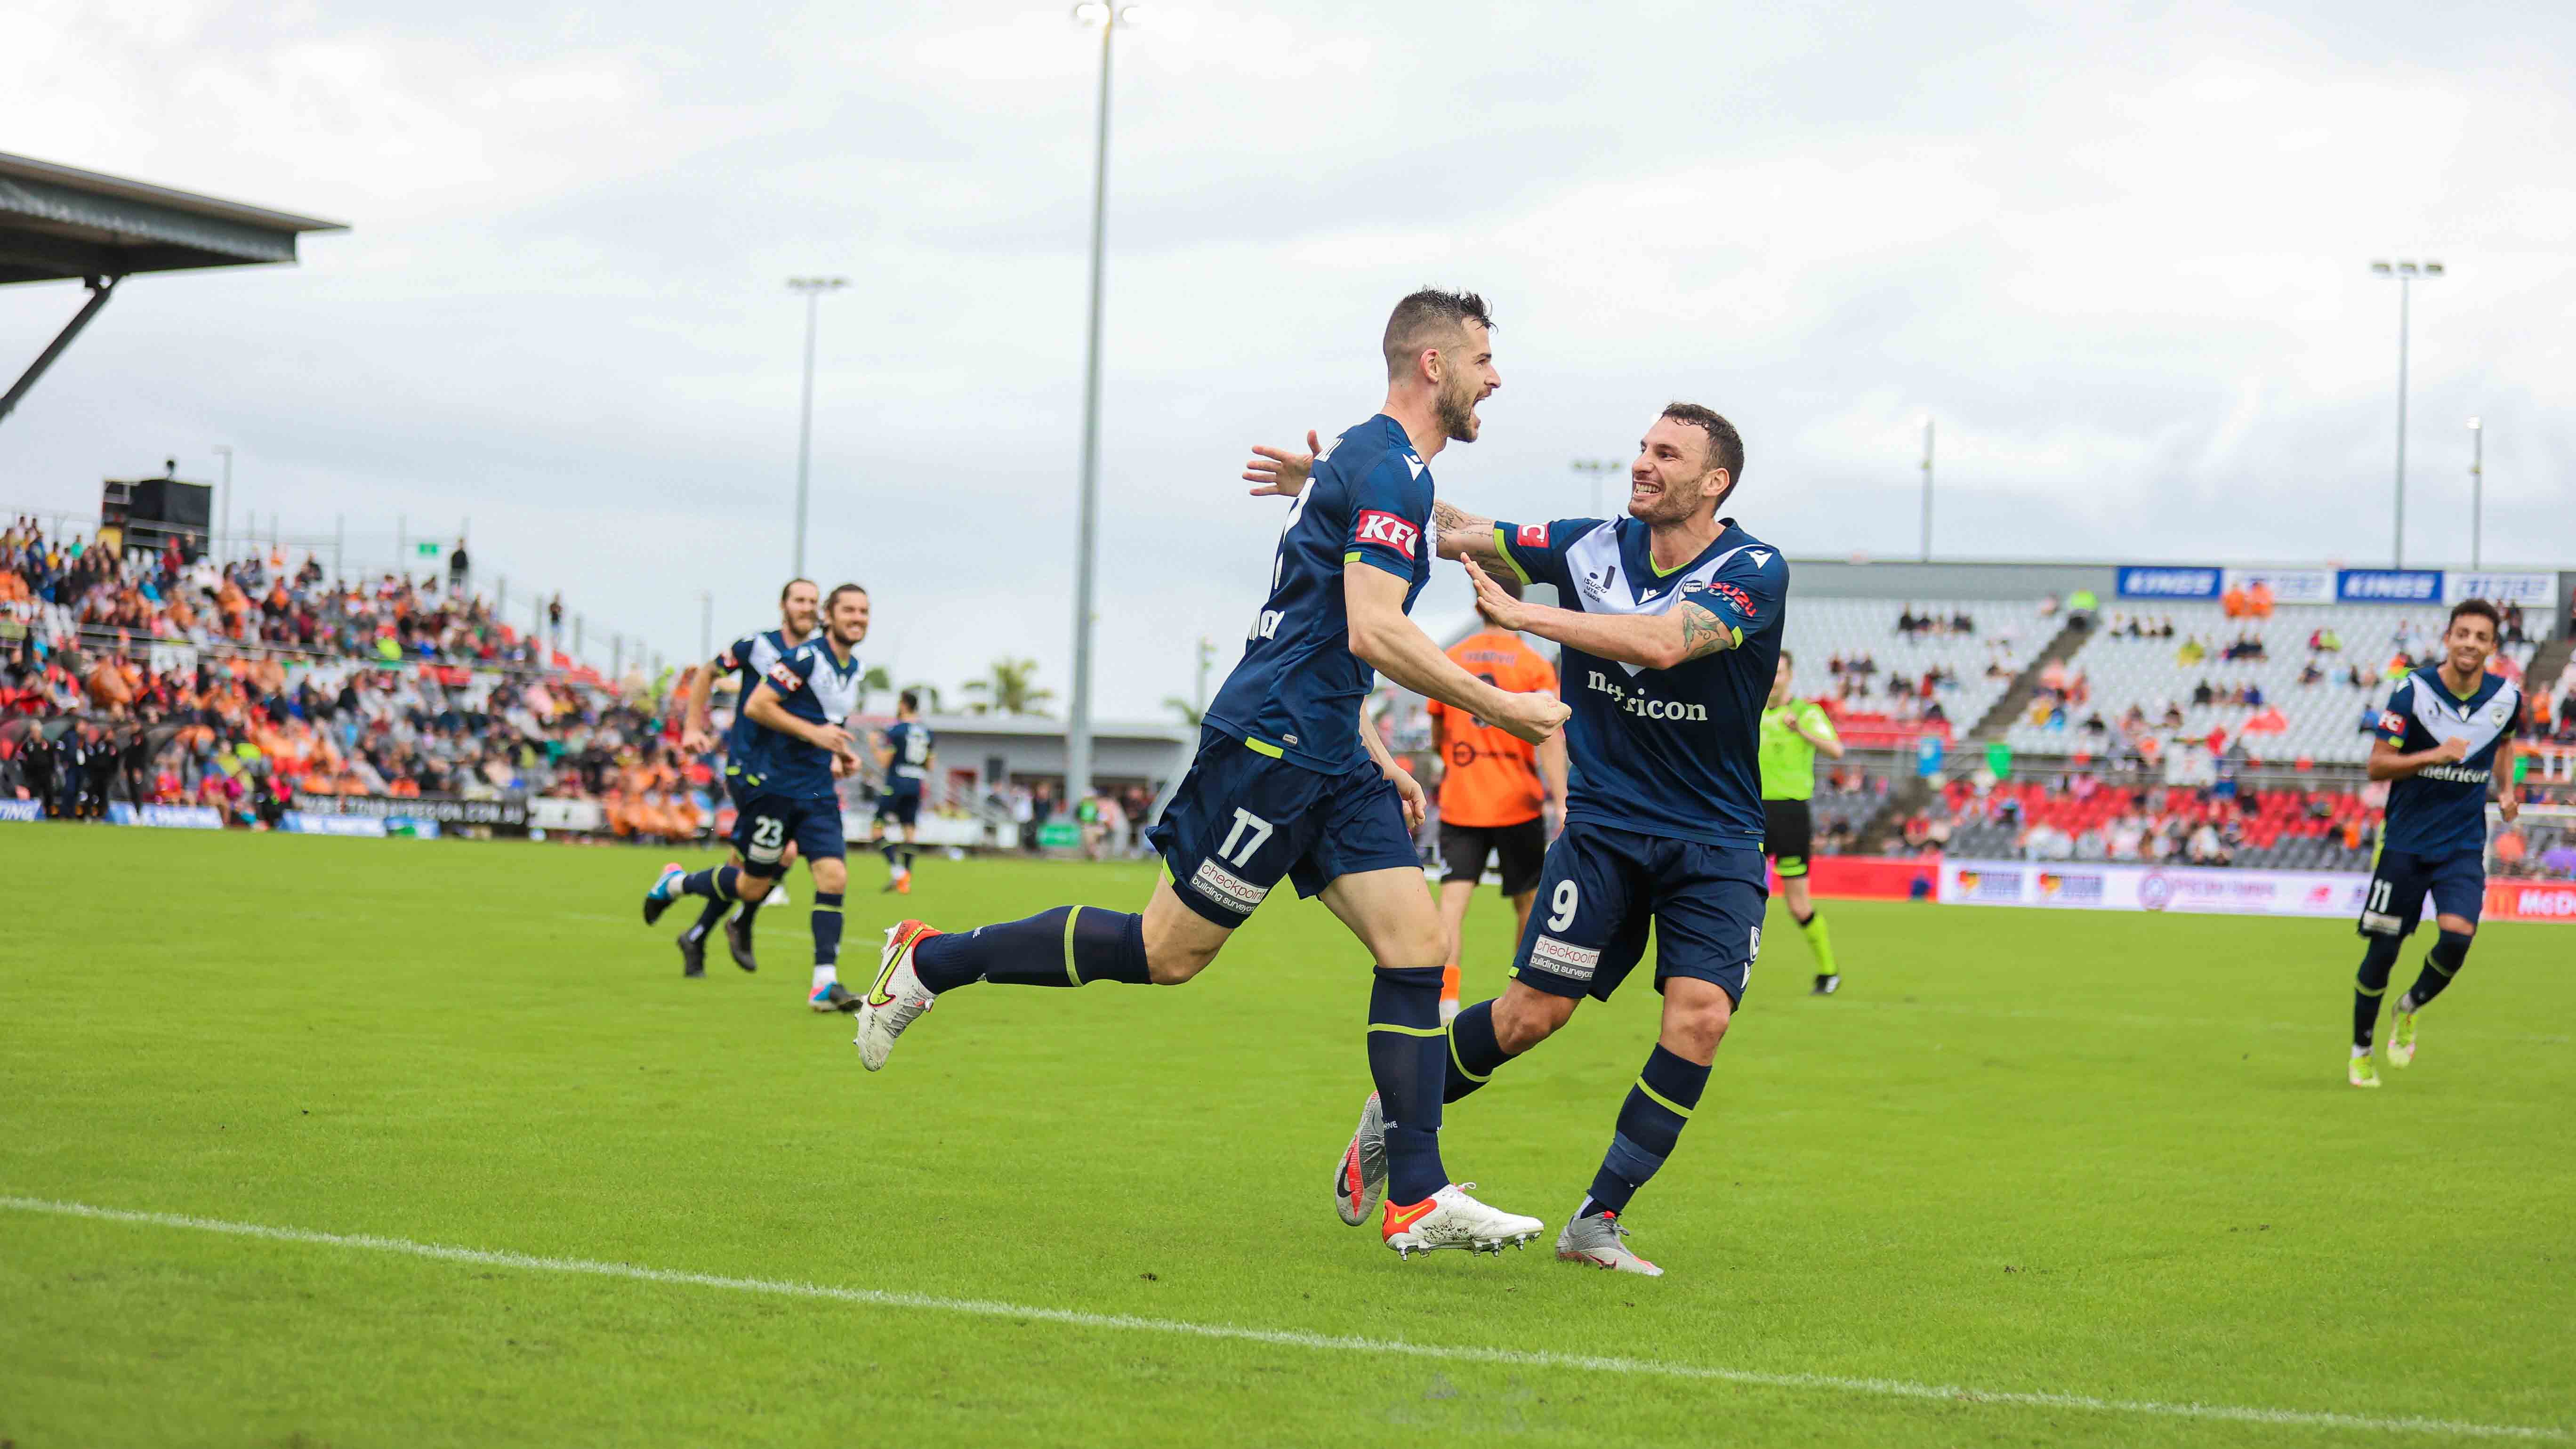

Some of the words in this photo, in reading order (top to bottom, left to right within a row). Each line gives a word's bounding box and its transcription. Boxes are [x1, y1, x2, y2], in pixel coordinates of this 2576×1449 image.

[752, 815, 784, 847] 23
[1217, 806, 1273, 868] 17
[1192, 876, 1223, 902] building
[1201, 864, 1265, 901] checkpoint
[2369, 879, 2393, 913] 11
[1547, 879, 1578, 932] 9
[1531, 955, 1560, 973] building
[1537, 940, 1597, 965] checkpoint
